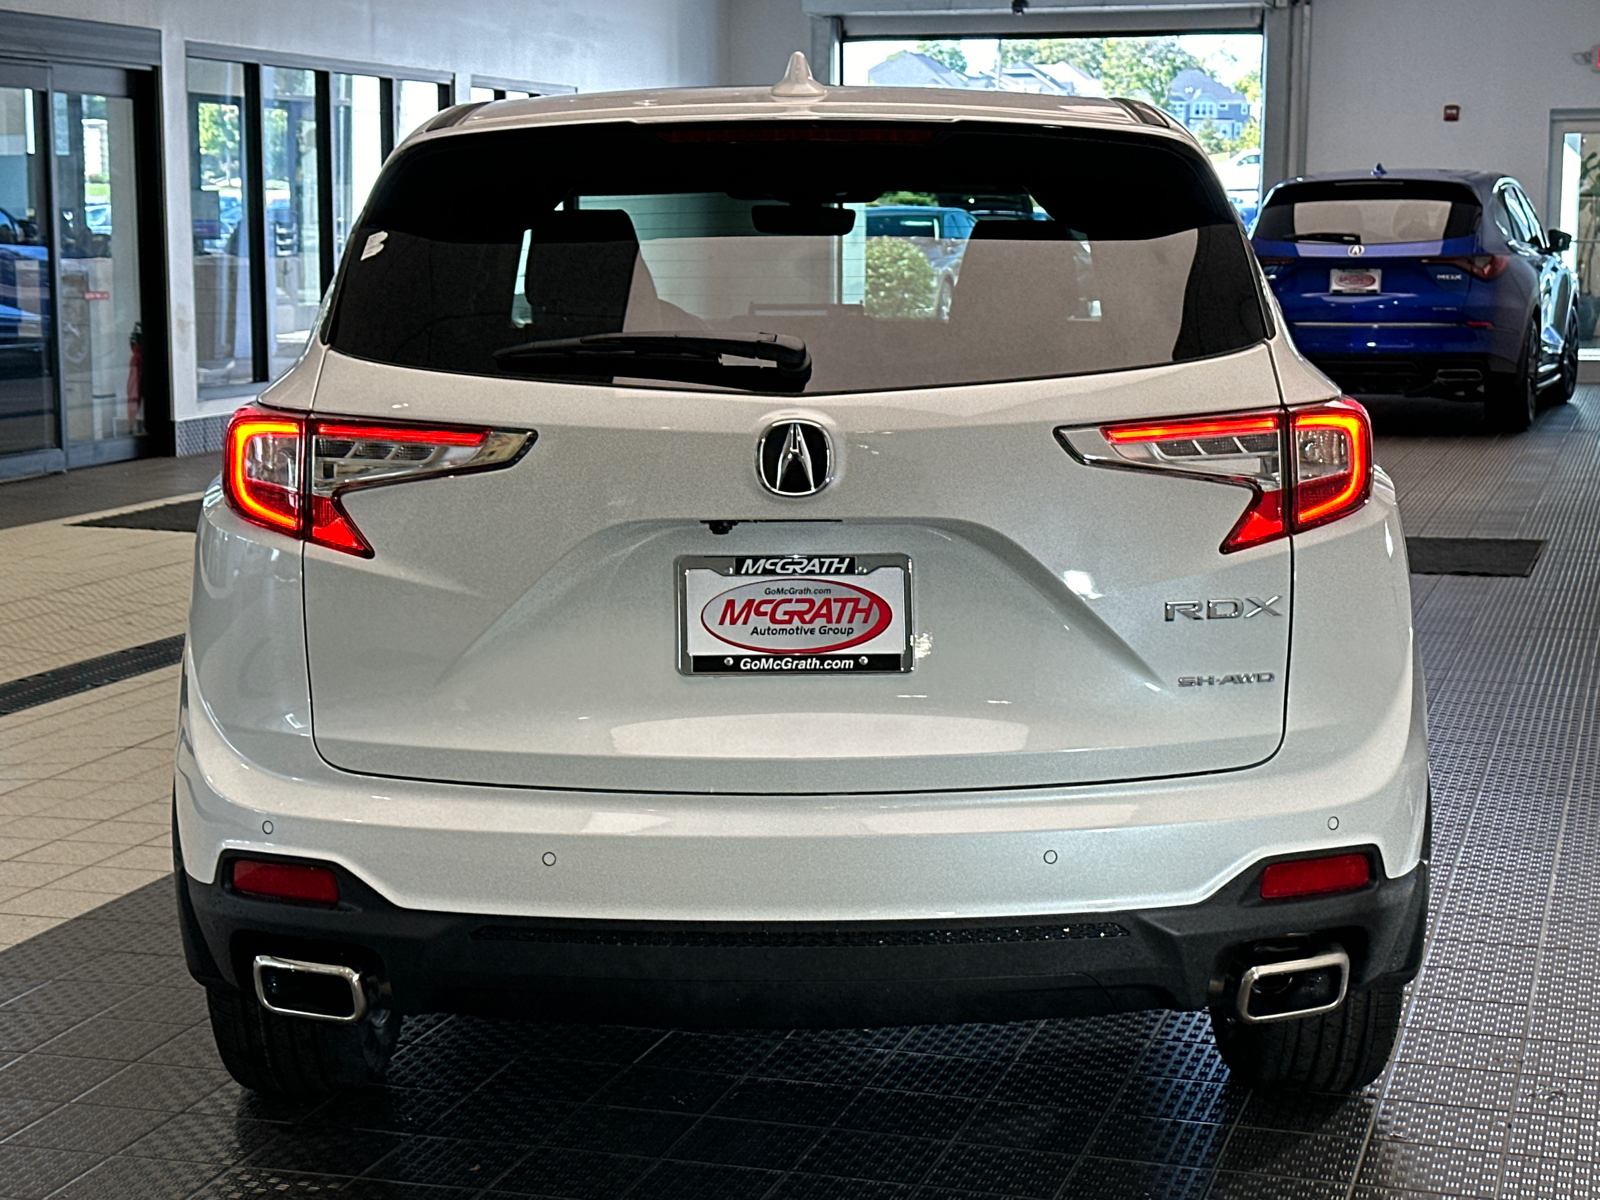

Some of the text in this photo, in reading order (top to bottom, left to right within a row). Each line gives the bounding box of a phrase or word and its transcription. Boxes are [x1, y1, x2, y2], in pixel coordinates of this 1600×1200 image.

[764, 587, 832, 596] GoMcGrath.com
[1164, 595, 1283, 622] RDX
[750, 625, 854, 637] Automotive Group
[739, 657, 854, 670] GoMcGrath.com
[1177, 672, 1275, 688] SH-AWD
